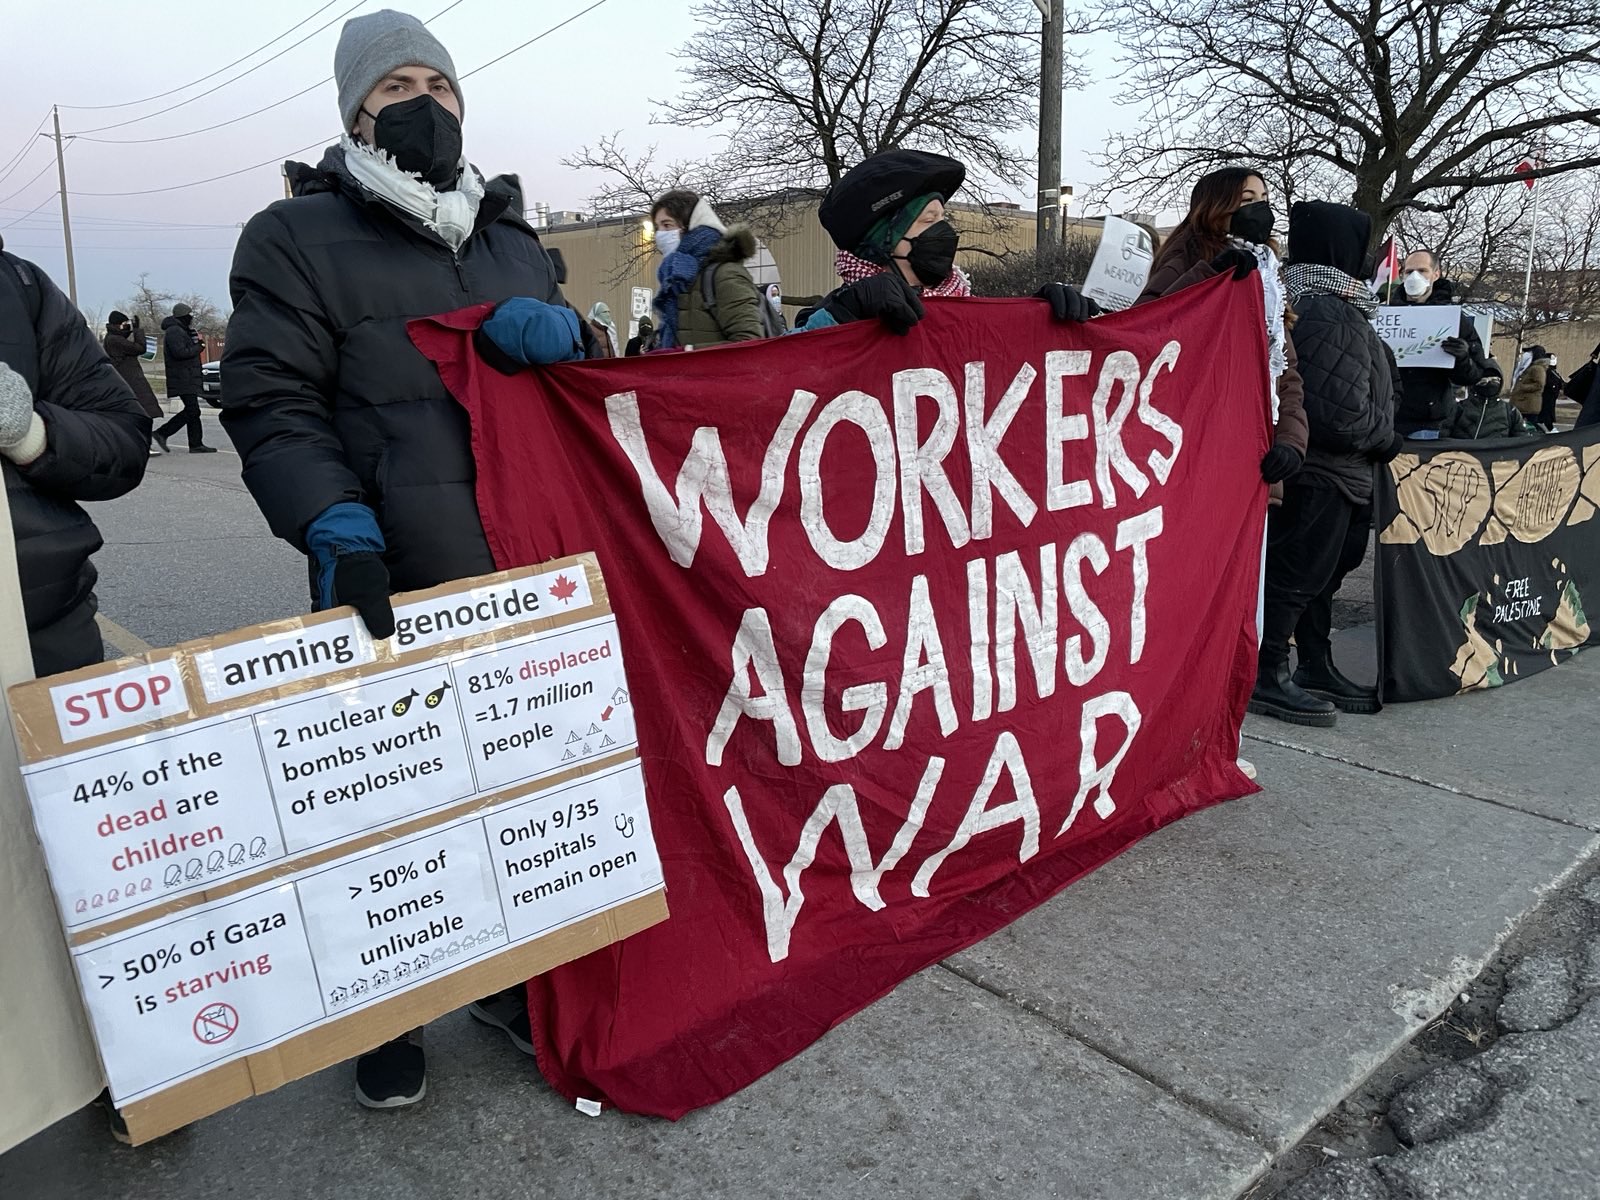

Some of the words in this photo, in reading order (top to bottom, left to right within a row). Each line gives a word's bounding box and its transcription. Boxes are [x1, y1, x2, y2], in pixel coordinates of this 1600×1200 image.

[604, 340, 1183, 577] WORKERS
[1493, 596, 1542, 623] PALESTINE
[1505, 577, 1529, 598] FREE
[223, 633, 354, 686] arming
[396, 589, 540, 645] genocide
[706, 505, 1164, 767] AGAINST
[467, 668, 515, 694] 81%
[518, 640, 613, 683] displaced
[65, 675, 171, 726] STOP
[274, 727, 291, 749] 2
[298, 700, 386, 743] nuclear
[475, 697, 520, 726] =1.7
[526, 680, 594, 713] million
[281, 747, 367, 783] bombs
[371, 720, 442, 756] worth
[481, 722, 554, 761] people
[73, 770, 134, 804] 44%
[142, 759, 170, 787] of
[176, 750, 223, 777] the
[290, 797, 317, 817] of
[322, 756, 444, 810] explosives
[97, 799, 168, 837] dead
[176, 790, 220, 815] are
[499, 818, 548, 848] Only
[551, 798, 601, 832] 9/35
[723, 690, 1142, 963] WAR
[111, 824, 225, 873] children
[504, 832, 597, 878] hospitals
[349, 884, 363, 901] >
[368, 861, 419, 895] 50%
[424, 849, 448, 874] of
[512, 868, 584, 908] remain
[588, 850, 639, 882] open
[366, 886, 444, 930] homes
[98, 972, 115, 990] >
[123, 943, 182, 983] 50%
[189, 929, 217, 957] of
[223, 911, 287, 945] Gaza
[360, 914, 465, 967] unlivable
[135, 993, 158, 1016] is
[164, 953, 273, 1004] starving
